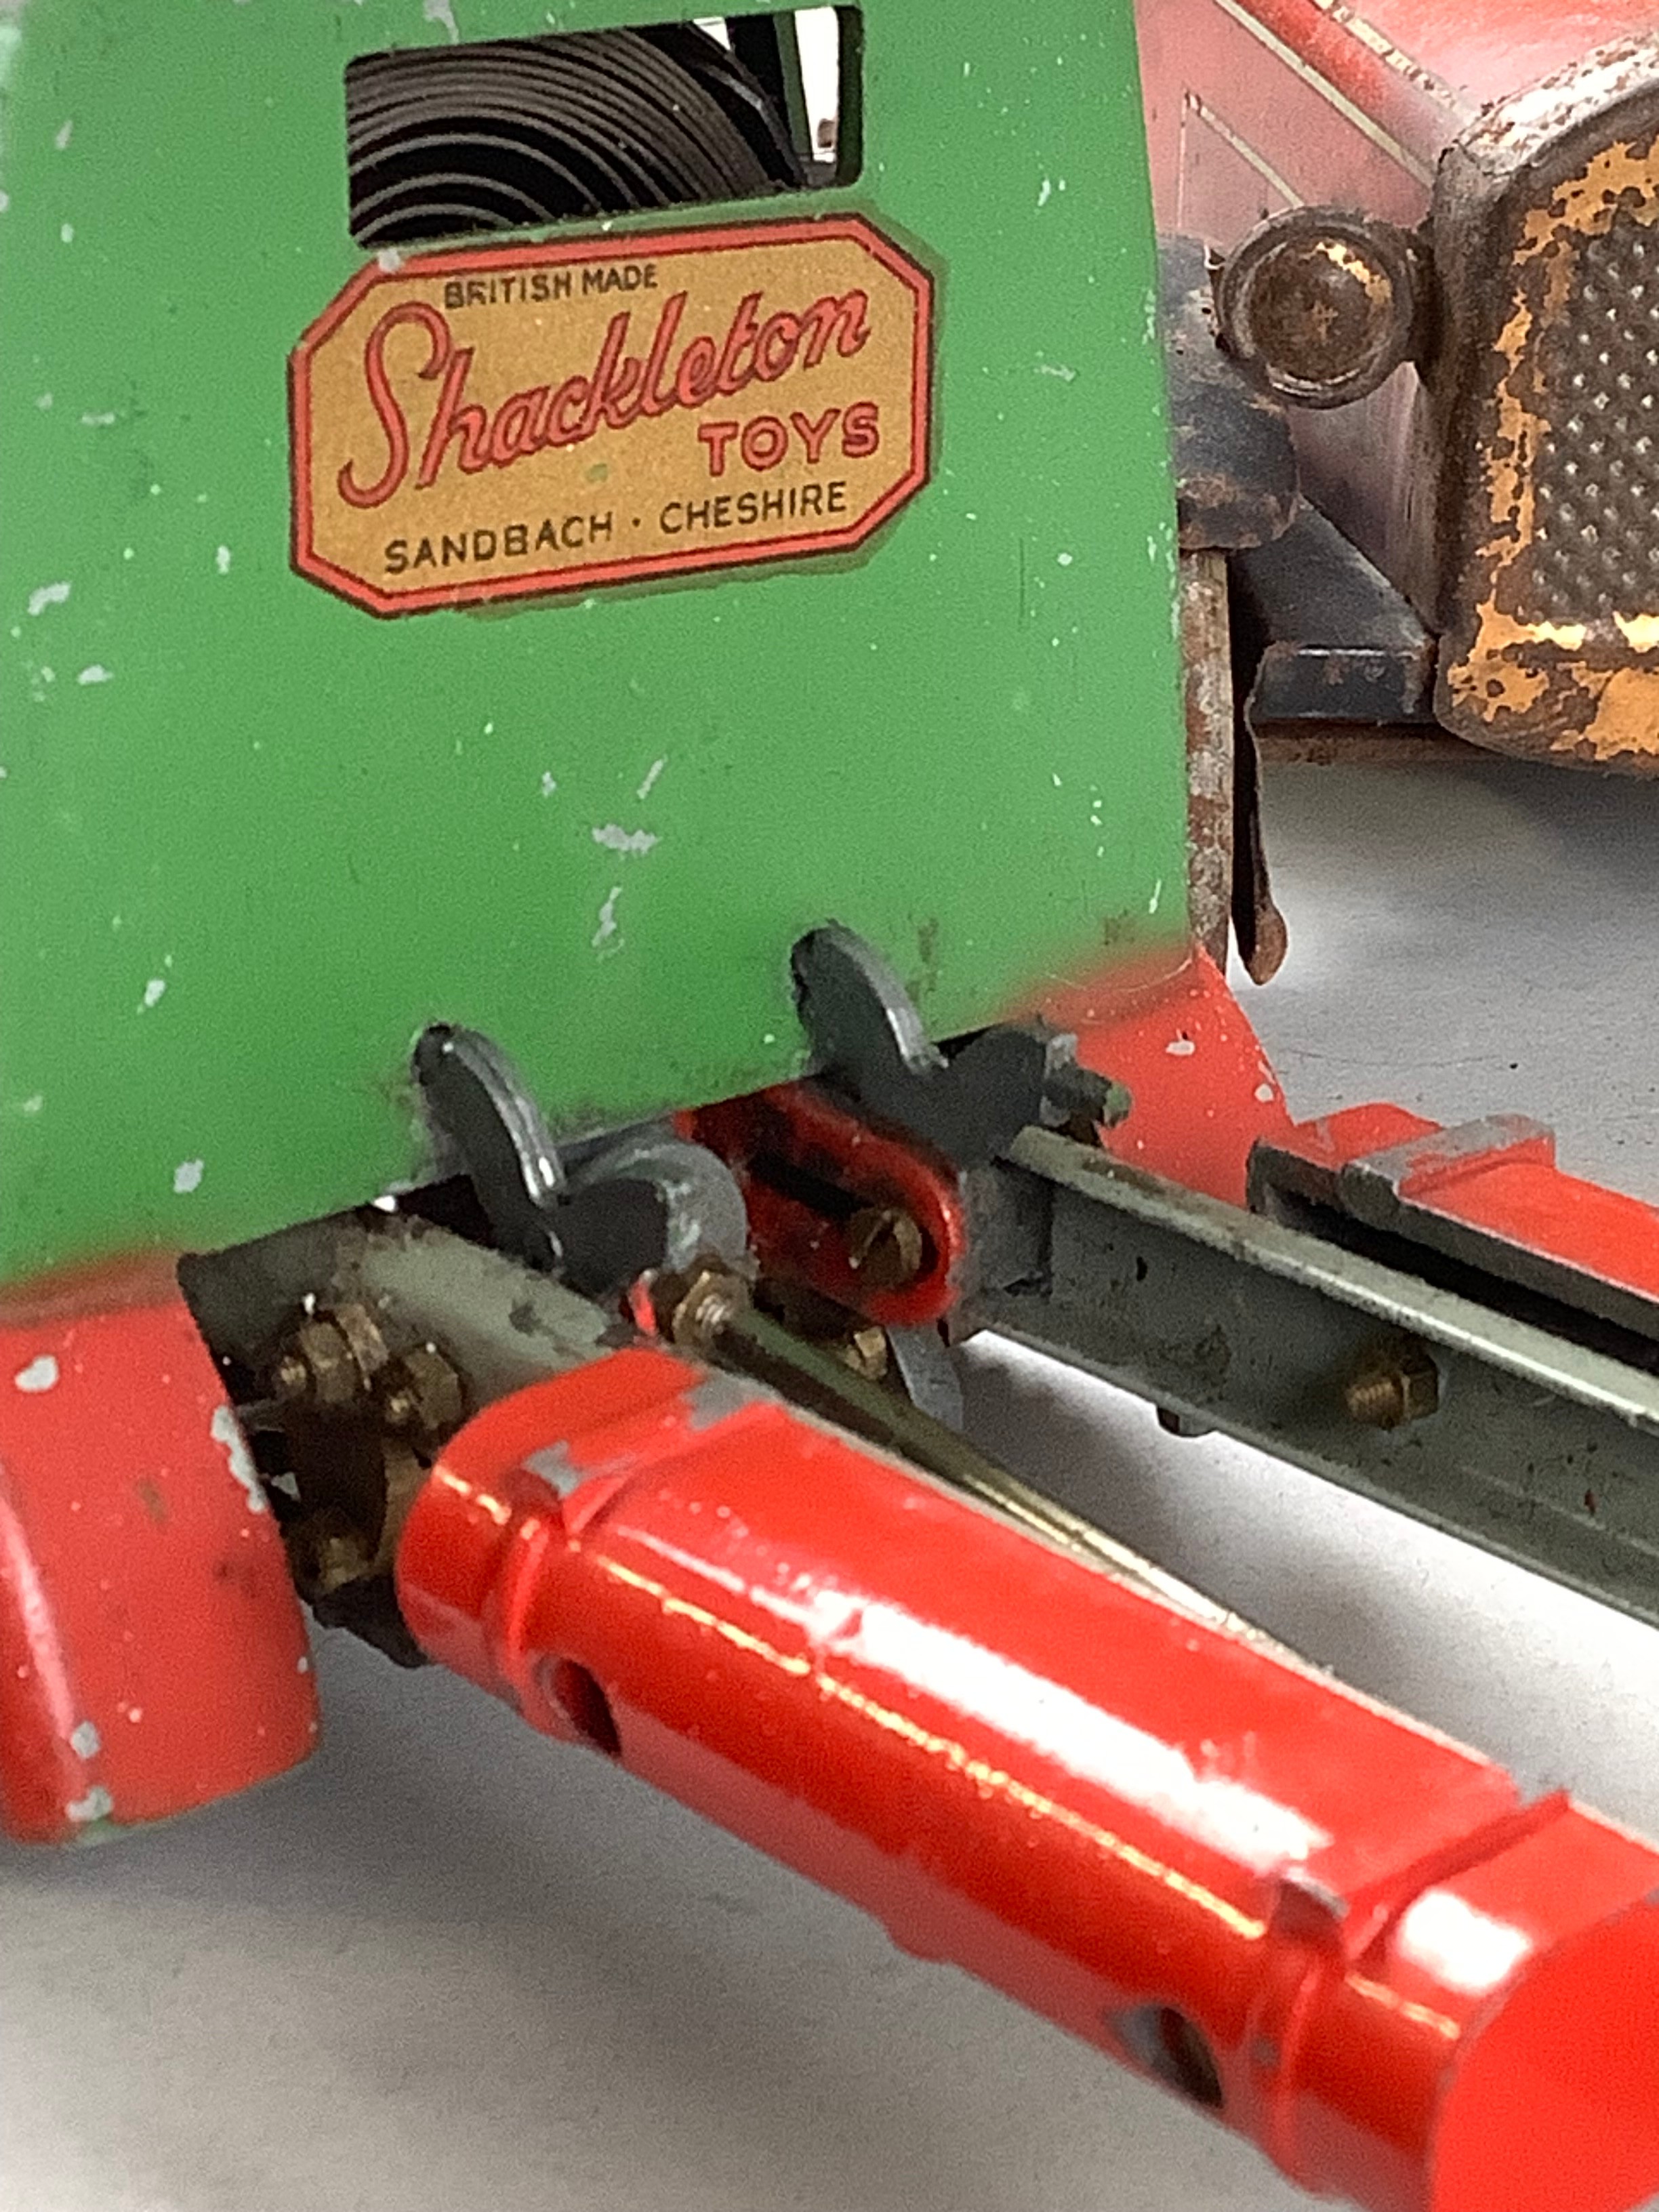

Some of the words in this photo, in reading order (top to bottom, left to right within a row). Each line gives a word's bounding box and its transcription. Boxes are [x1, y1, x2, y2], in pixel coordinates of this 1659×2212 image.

[445, 272, 573, 309] BRITISH
[581, 264, 658, 293] MADE
[337, 289, 871, 508] Shackleton
[698, 403, 880, 476] TOYS
[384, 512, 613, 575] SANDBACH
[659, 482, 847, 534] CHESHIRE
